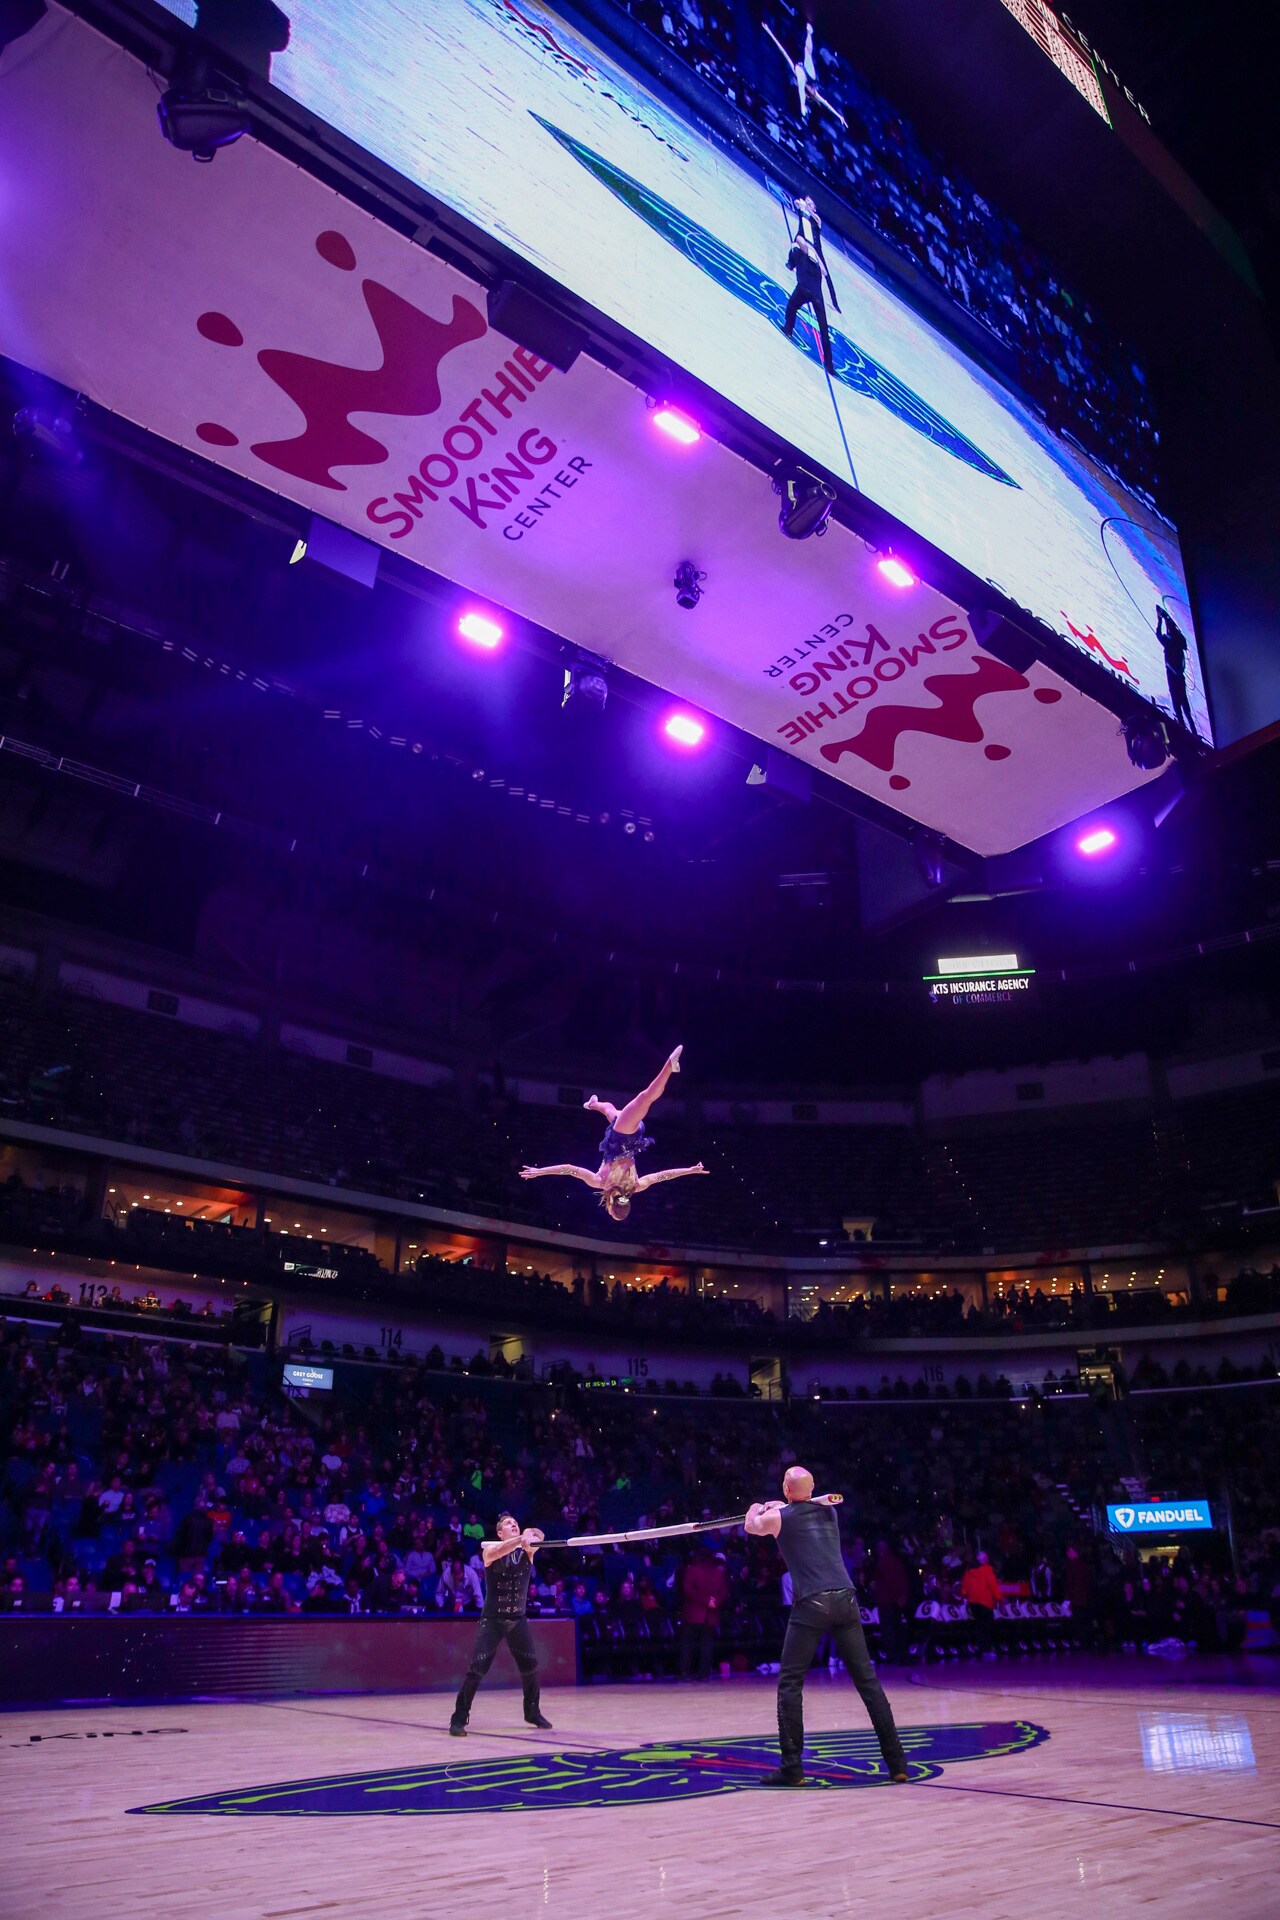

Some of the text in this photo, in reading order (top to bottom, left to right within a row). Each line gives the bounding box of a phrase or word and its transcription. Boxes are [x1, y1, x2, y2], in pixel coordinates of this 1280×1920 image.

[1062, 12, 1152, 125] CENTER
[503, 456, 593, 541] CENTER
[763, 614, 854, 678] CENTER
[777, 615, 968, 745] SMOOTHIE
[932, 978, 1029, 995] KTS INSURANCE AGENCY
[965, 991, 1012, 1004] COMMERCE
[380, 1327, 402, 1349] 114
[292, 1370, 324, 1380] GREY GOOSE
[627, 1358, 648, 1377] 115
[923, 1364, 944, 1382] 116
[1137, 1509, 1203, 1524] FANDUEL
